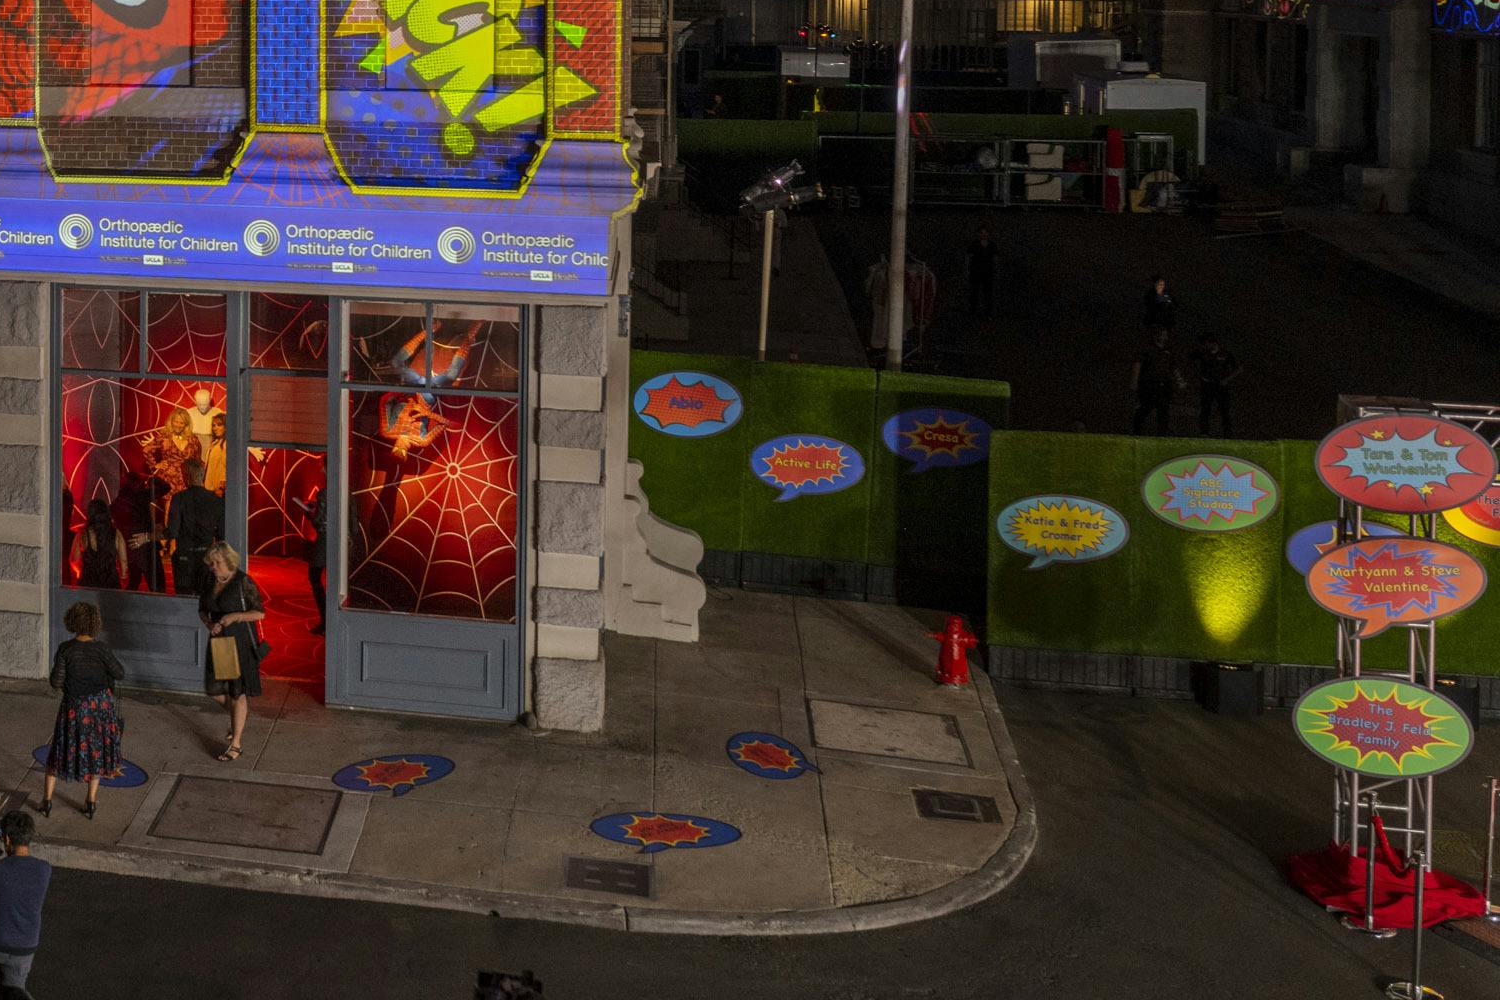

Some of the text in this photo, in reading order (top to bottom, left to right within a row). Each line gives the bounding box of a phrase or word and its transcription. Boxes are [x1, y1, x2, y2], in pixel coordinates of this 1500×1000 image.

[99, 217, 184, 235] Orthopædic
[285, 224, 374, 241] Orthopædic
[100, 234, 238, 252] Institute for Children
[482, 231, 574, 249] Orthopædic
[286, 241, 432, 260] Institute for Children
[483, 249, 543, 264] Institute
[546, 250, 566, 265] for
[924, 429, 959, 444] Cresa
[1400, 449, 1413, 461] &
[1420, 448, 1448, 461] Tom
[775, 456, 837, 471] Active Life
[1024, 515, 1100, 530] Katie & Fred
[1330, 566, 1461, 581] Martyann & Steve
[1364, 582, 1430, 593] Valentine
[1368, 703, 1393, 716] The
[1327, 713, 1432, 736] Bradley J. Feld
[1357, 732, 1400, 749] Family
